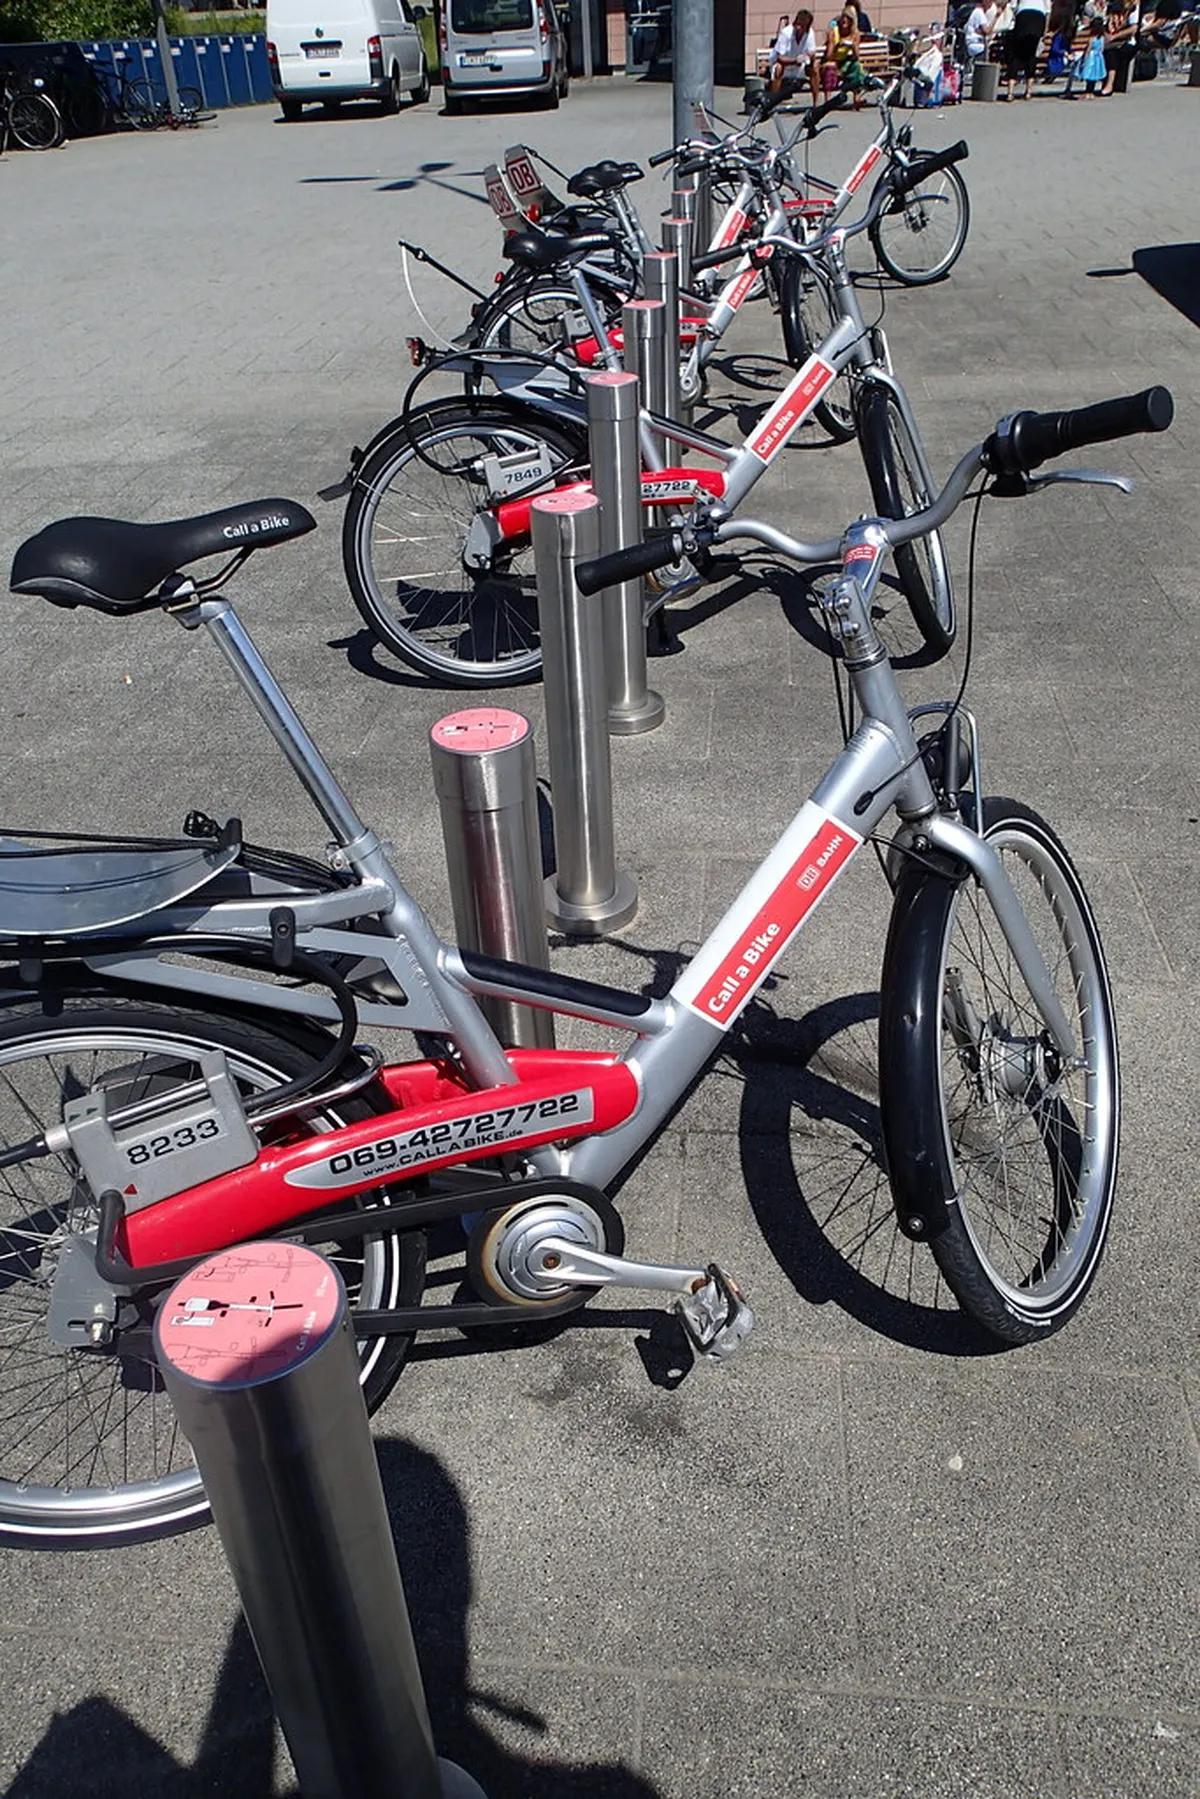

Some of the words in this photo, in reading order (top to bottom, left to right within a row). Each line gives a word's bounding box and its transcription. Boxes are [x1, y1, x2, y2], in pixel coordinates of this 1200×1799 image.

[504, 466, 543, 485] 7849
[222, 523, 250, 539] Call
[250, 522, 260, 534] a
[260, 515, 290, 531] Bike
[815, 833, 844, 868] BAHN
[743, 921, 781, 965] Bike
[736, 964, 751, 980] a
[707, 975, 741, 1014] Call
[126, 1118, 220, 1165] 8233
[329, 1094, 580, 1176] 069.42727722
